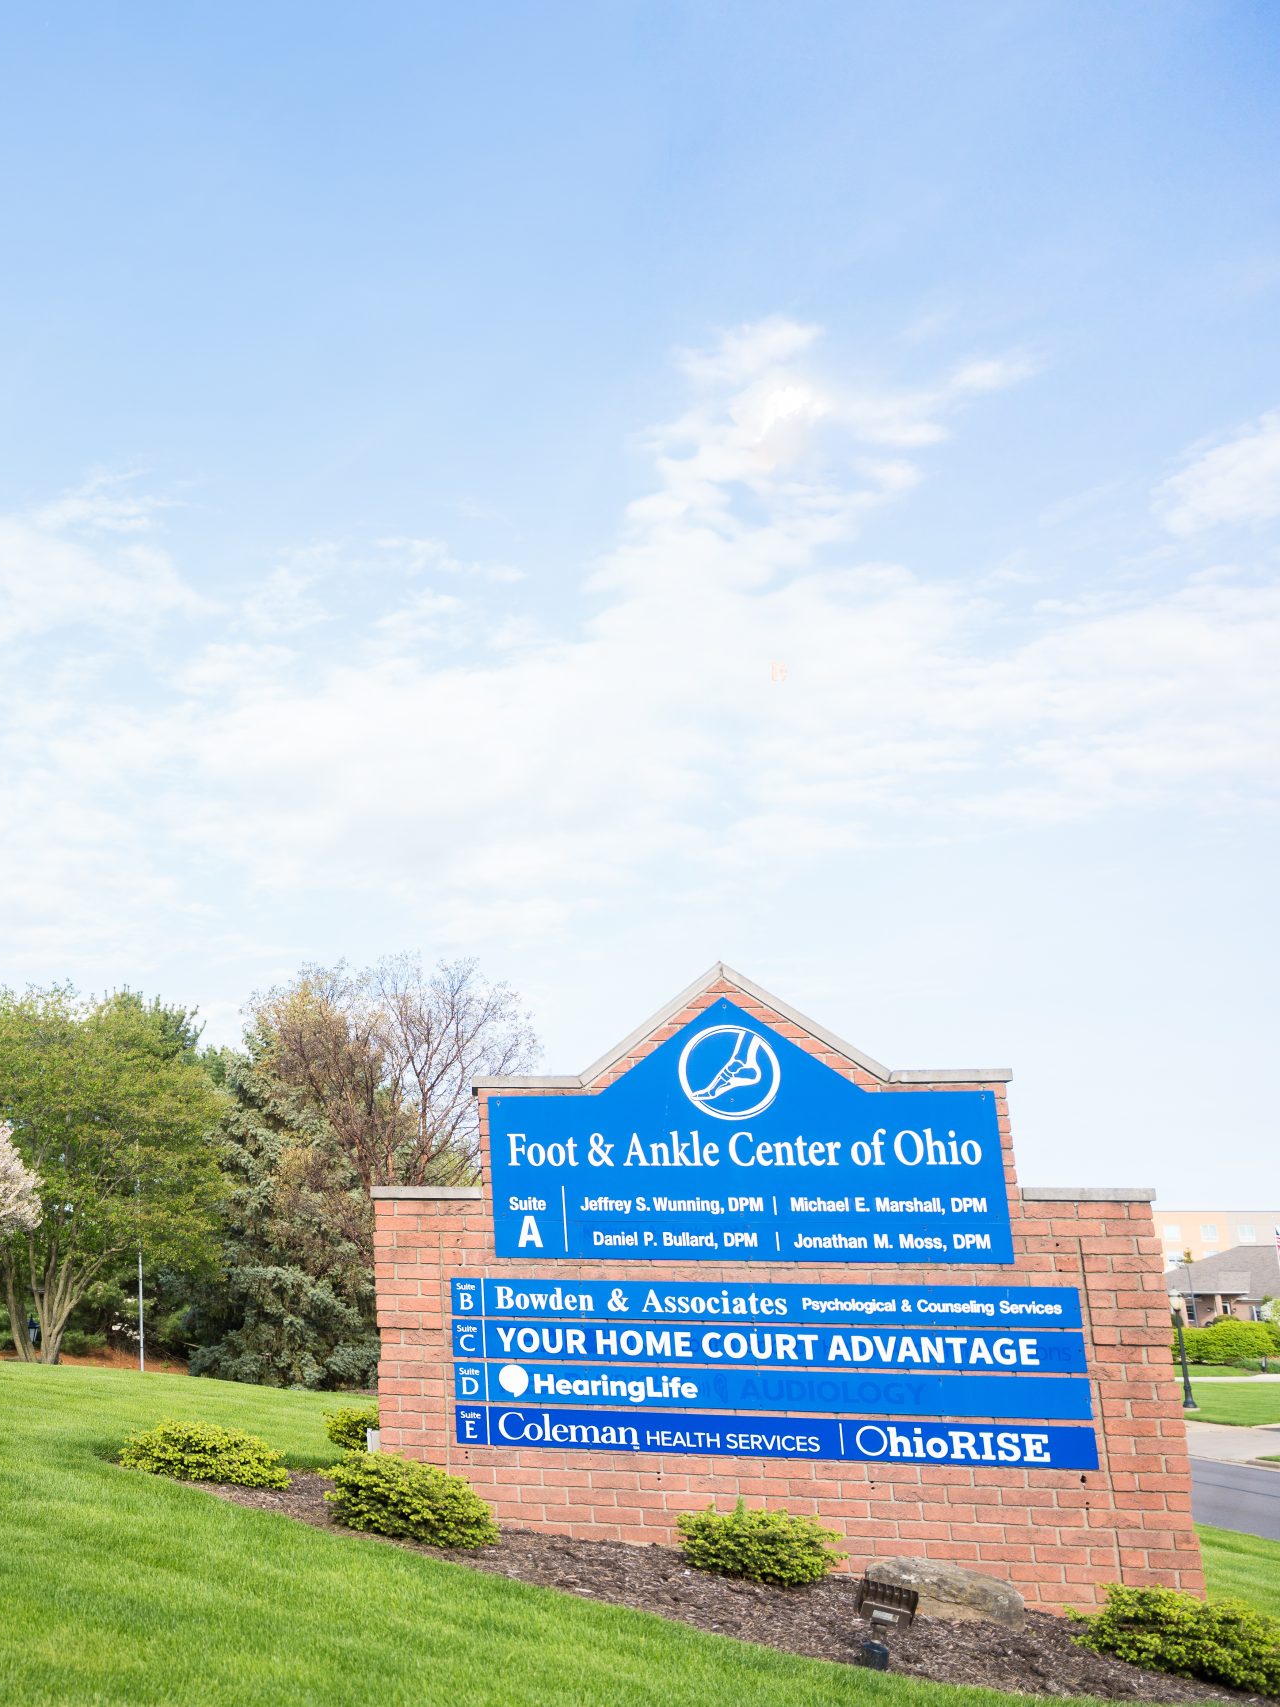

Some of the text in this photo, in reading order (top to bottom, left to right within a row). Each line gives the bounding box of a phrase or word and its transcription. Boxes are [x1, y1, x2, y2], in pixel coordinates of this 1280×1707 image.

[507, 1128, 982, 1166] Foot & Ankle Center of Ohio
[509, 1197, 546, 1210] Suite
[581, 1197, 763, 1214] Jeffrey S. Wunning, DPM
[790, 1197, 987, 1215] Michael E. Marshall, DPM
[518, 1216, 543, 1247] A
[593, 1232, 758, 1249] Daniel P. Bullard, DPM
[794, 1234, 991, 1251] Jonathan M. Moss, DPM
[460, 1293, 473, 1310] B
[496, 1286, 787, 1315] Bowden & Associates
[802, 1298, 1062, 1316] Psychological & Counseling Services
[460, 1334, 475, 1351] C
[497, 1328, 587, 1354] YOUR
[596, 1330, 692, 1357] HOME
[702, 1333, 818, 1360] COURT
[828, 1335, 1040, 1365] ADVANTAGE
[462, 1377, 478, 1394] D
[534, 1374, 698, 1402] HearingLife
[741, 1377, 926, 1405] AUDIOLOGY
[461, 1411, 481, 1419] Suite
[466, 1421, 477, 1438] E
[499, 1411, 820, 1452] Coleman HEALTH SERVICES
[856, 1426, 1050, 1463] OhioRISE
